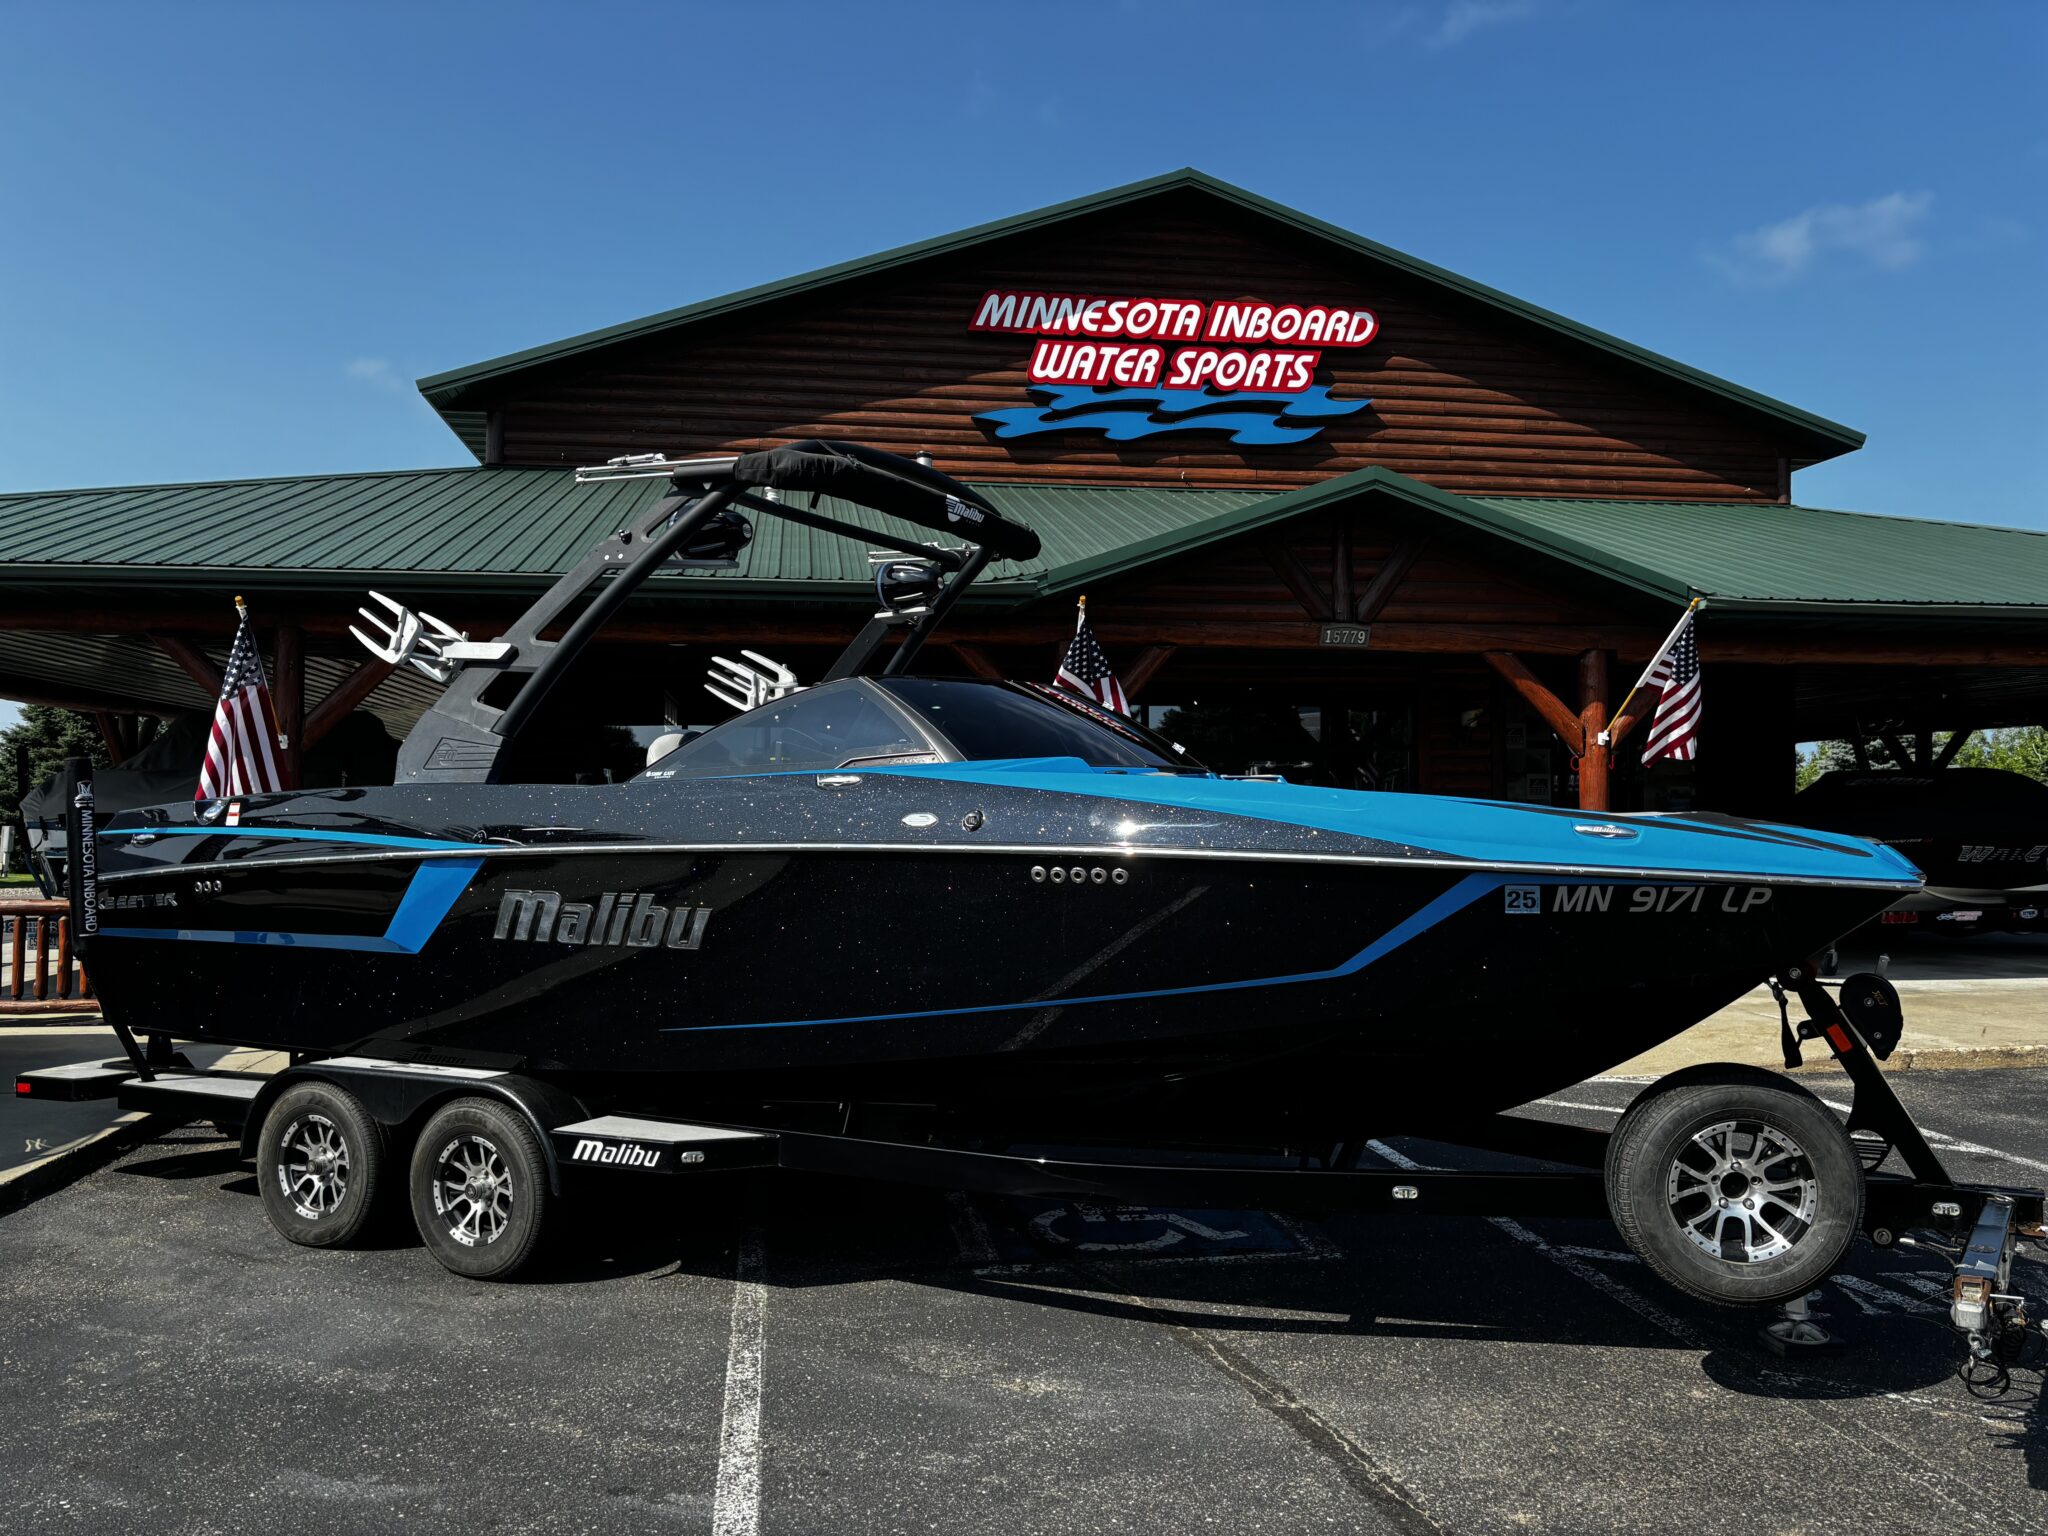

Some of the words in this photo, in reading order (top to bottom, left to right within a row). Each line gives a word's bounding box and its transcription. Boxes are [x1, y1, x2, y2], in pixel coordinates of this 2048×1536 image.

[975, 293, 1201, 337] MINNESOTA
[1209, 303, 1375, 343] INBOARD
[1032, 343, 1160, 383] WATER
[1173, 350, 1315, 388] SPORTS
[953, 502, 985, 523] Malibu
[1325, 630, 1366, 644] 15779
[81, 809, 95, 878] MINNESOTA
[83, 879, 98, 932] INBOARD
[1507, 891, 1537, 909] 25
[1552, 885, 1614, 913] MN
[1629, 886, 1705, 913] 9171
[1721, 887, 1773, 913] LP
[493, 888, 713, 950] Malibu
[572, 1139, 661, 1167] Malibu
